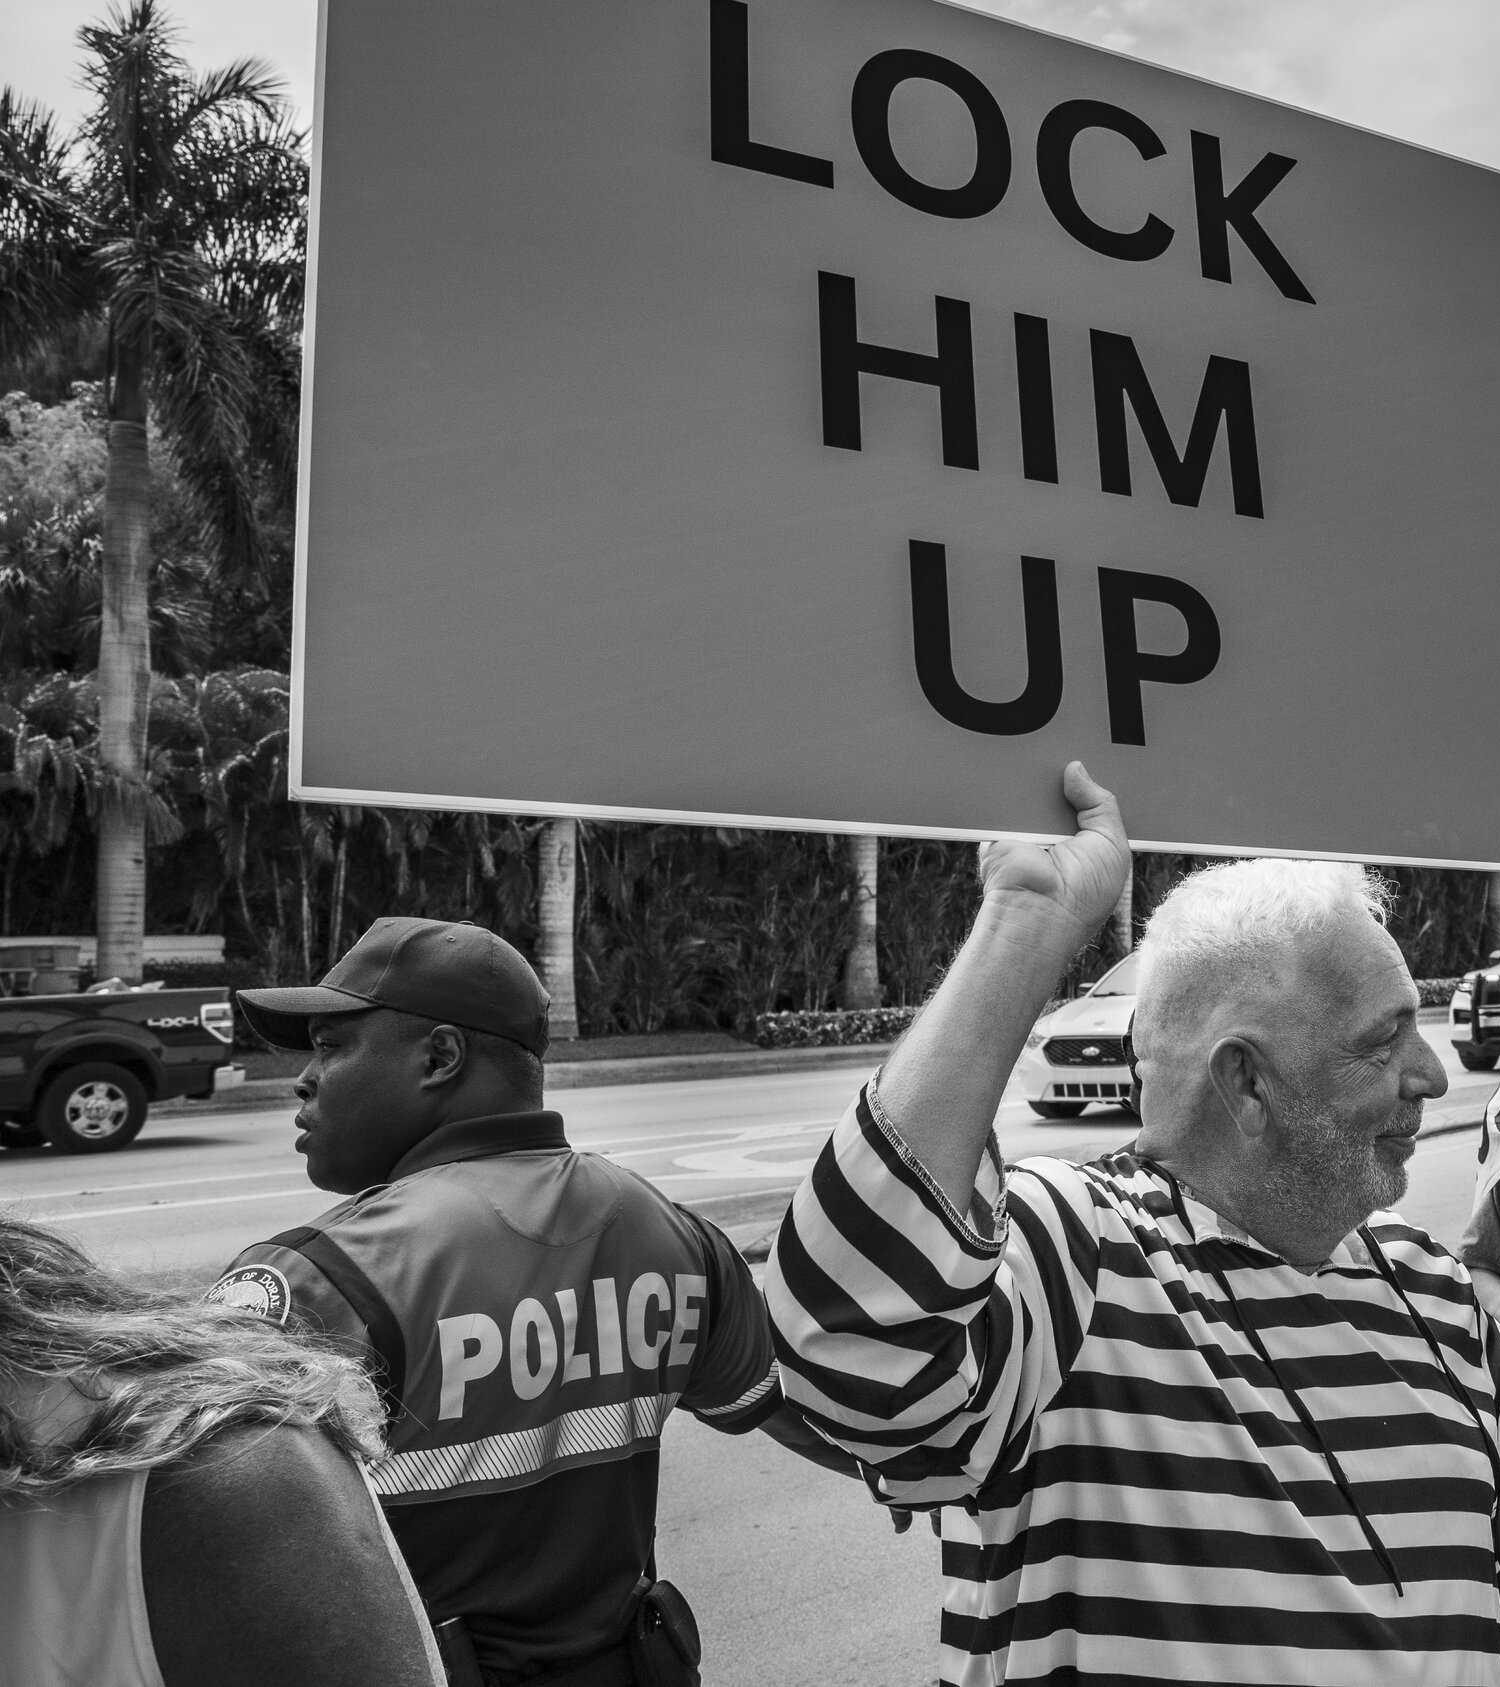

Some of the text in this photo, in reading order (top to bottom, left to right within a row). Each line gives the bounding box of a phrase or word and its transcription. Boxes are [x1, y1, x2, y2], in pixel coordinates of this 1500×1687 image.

[710, 0, 1317, 305] LOCK
[818, 270, 1265, 519] HIM
[909, 539, 1222, 747] UP
[208, 1272, 281, 1309] CITY OF DORAL
[437, 1272, 707, 1421] POLICE
